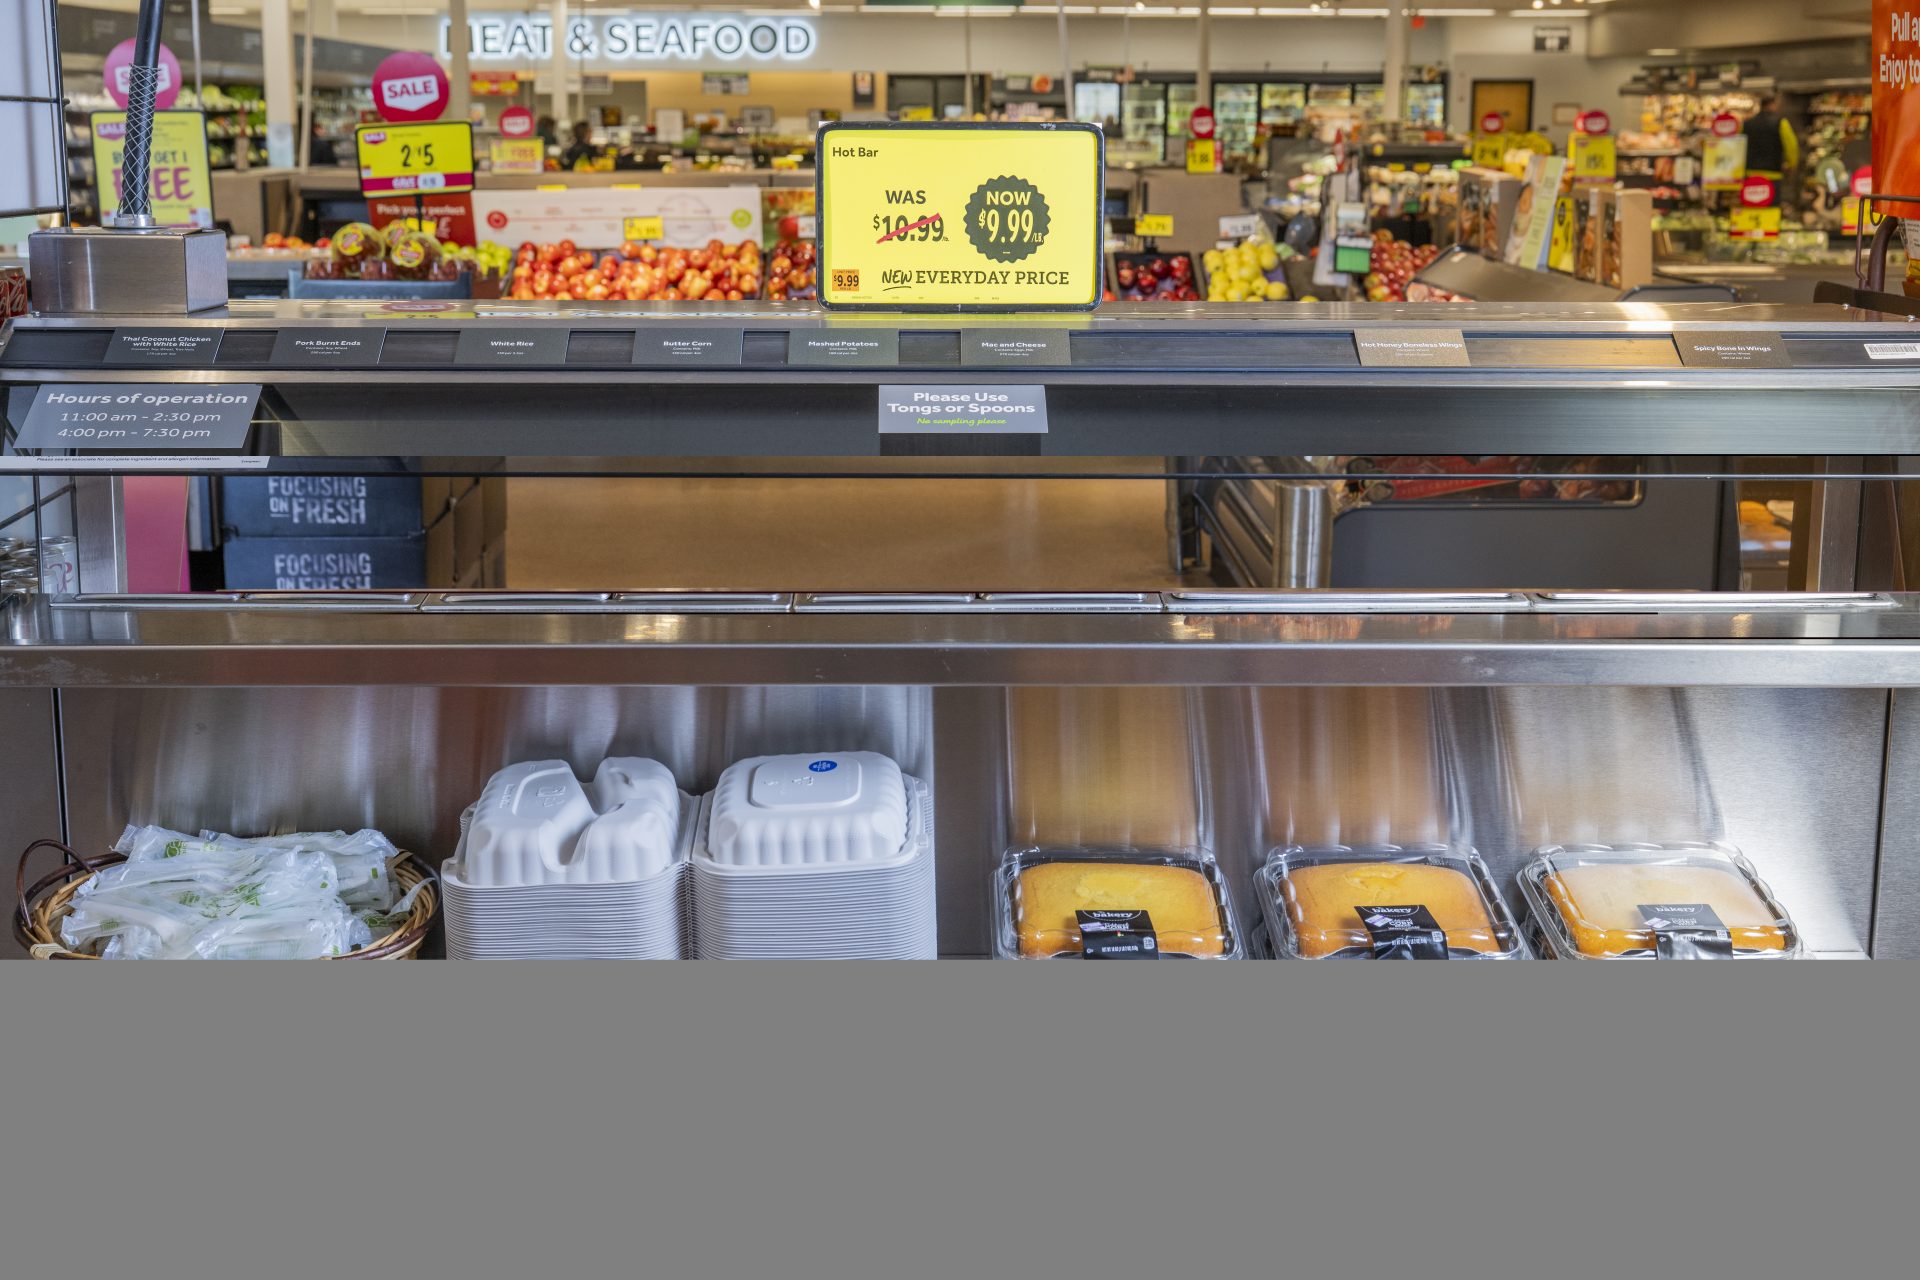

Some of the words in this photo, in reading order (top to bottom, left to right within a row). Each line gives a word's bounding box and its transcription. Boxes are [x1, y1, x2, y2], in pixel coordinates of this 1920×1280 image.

[1891, 11, 1910, 41] Pull
[569, 23, 593, 54] &
[608, 24, 811, 54] SEAFOOD
[1880, 53, 1907, 90] Enjoy
[388, 79, 434, 99] SALE
[832, 147, 855, 158] Hot
[858, 147, 879, 158] Bar
[885, 190, 926, 204] WAS
[986, 191, 1031, 205] NOW
[833, 275, 859, 287] $9.99
[881, 269, 912, 284] NEW
[916, 271, 1011, 285] EVERYDAY
[1015, 271, 1070, 285] PRICE
[47, 393, 111, 405] Hours
[117, 393, 142, 404] of
[143, 394, 249, 406] operation
[913, 392, 971, 402] Please
[974, 392, 1009, 402] Use
[887, 403, 942, 415] Tongs
[945, 405, 965, 413] or
[968, 403, 1036, 415] Spoons
[60, 413, 107, 422] 11:00
[110, 414, 137, 422] am
[152, 413, 191, 422] 2:30
[193, 414, 221, 424] pm
[933, 417, 975, 426] sampling
[977, 417, 1007, 426] please
[57, 428, 95, 437] 4:00
[97, 430, 126, 440] pm
[143, 428, 180, 437] 7:30
[182, 429, 211, 439] pm
[268, 476, 367, 497] FOCUSING
[270, 497, 289, 513] ON
[292, 499, 366, 524] FRESH
[274, 553, 371, 576] FOCUSING
